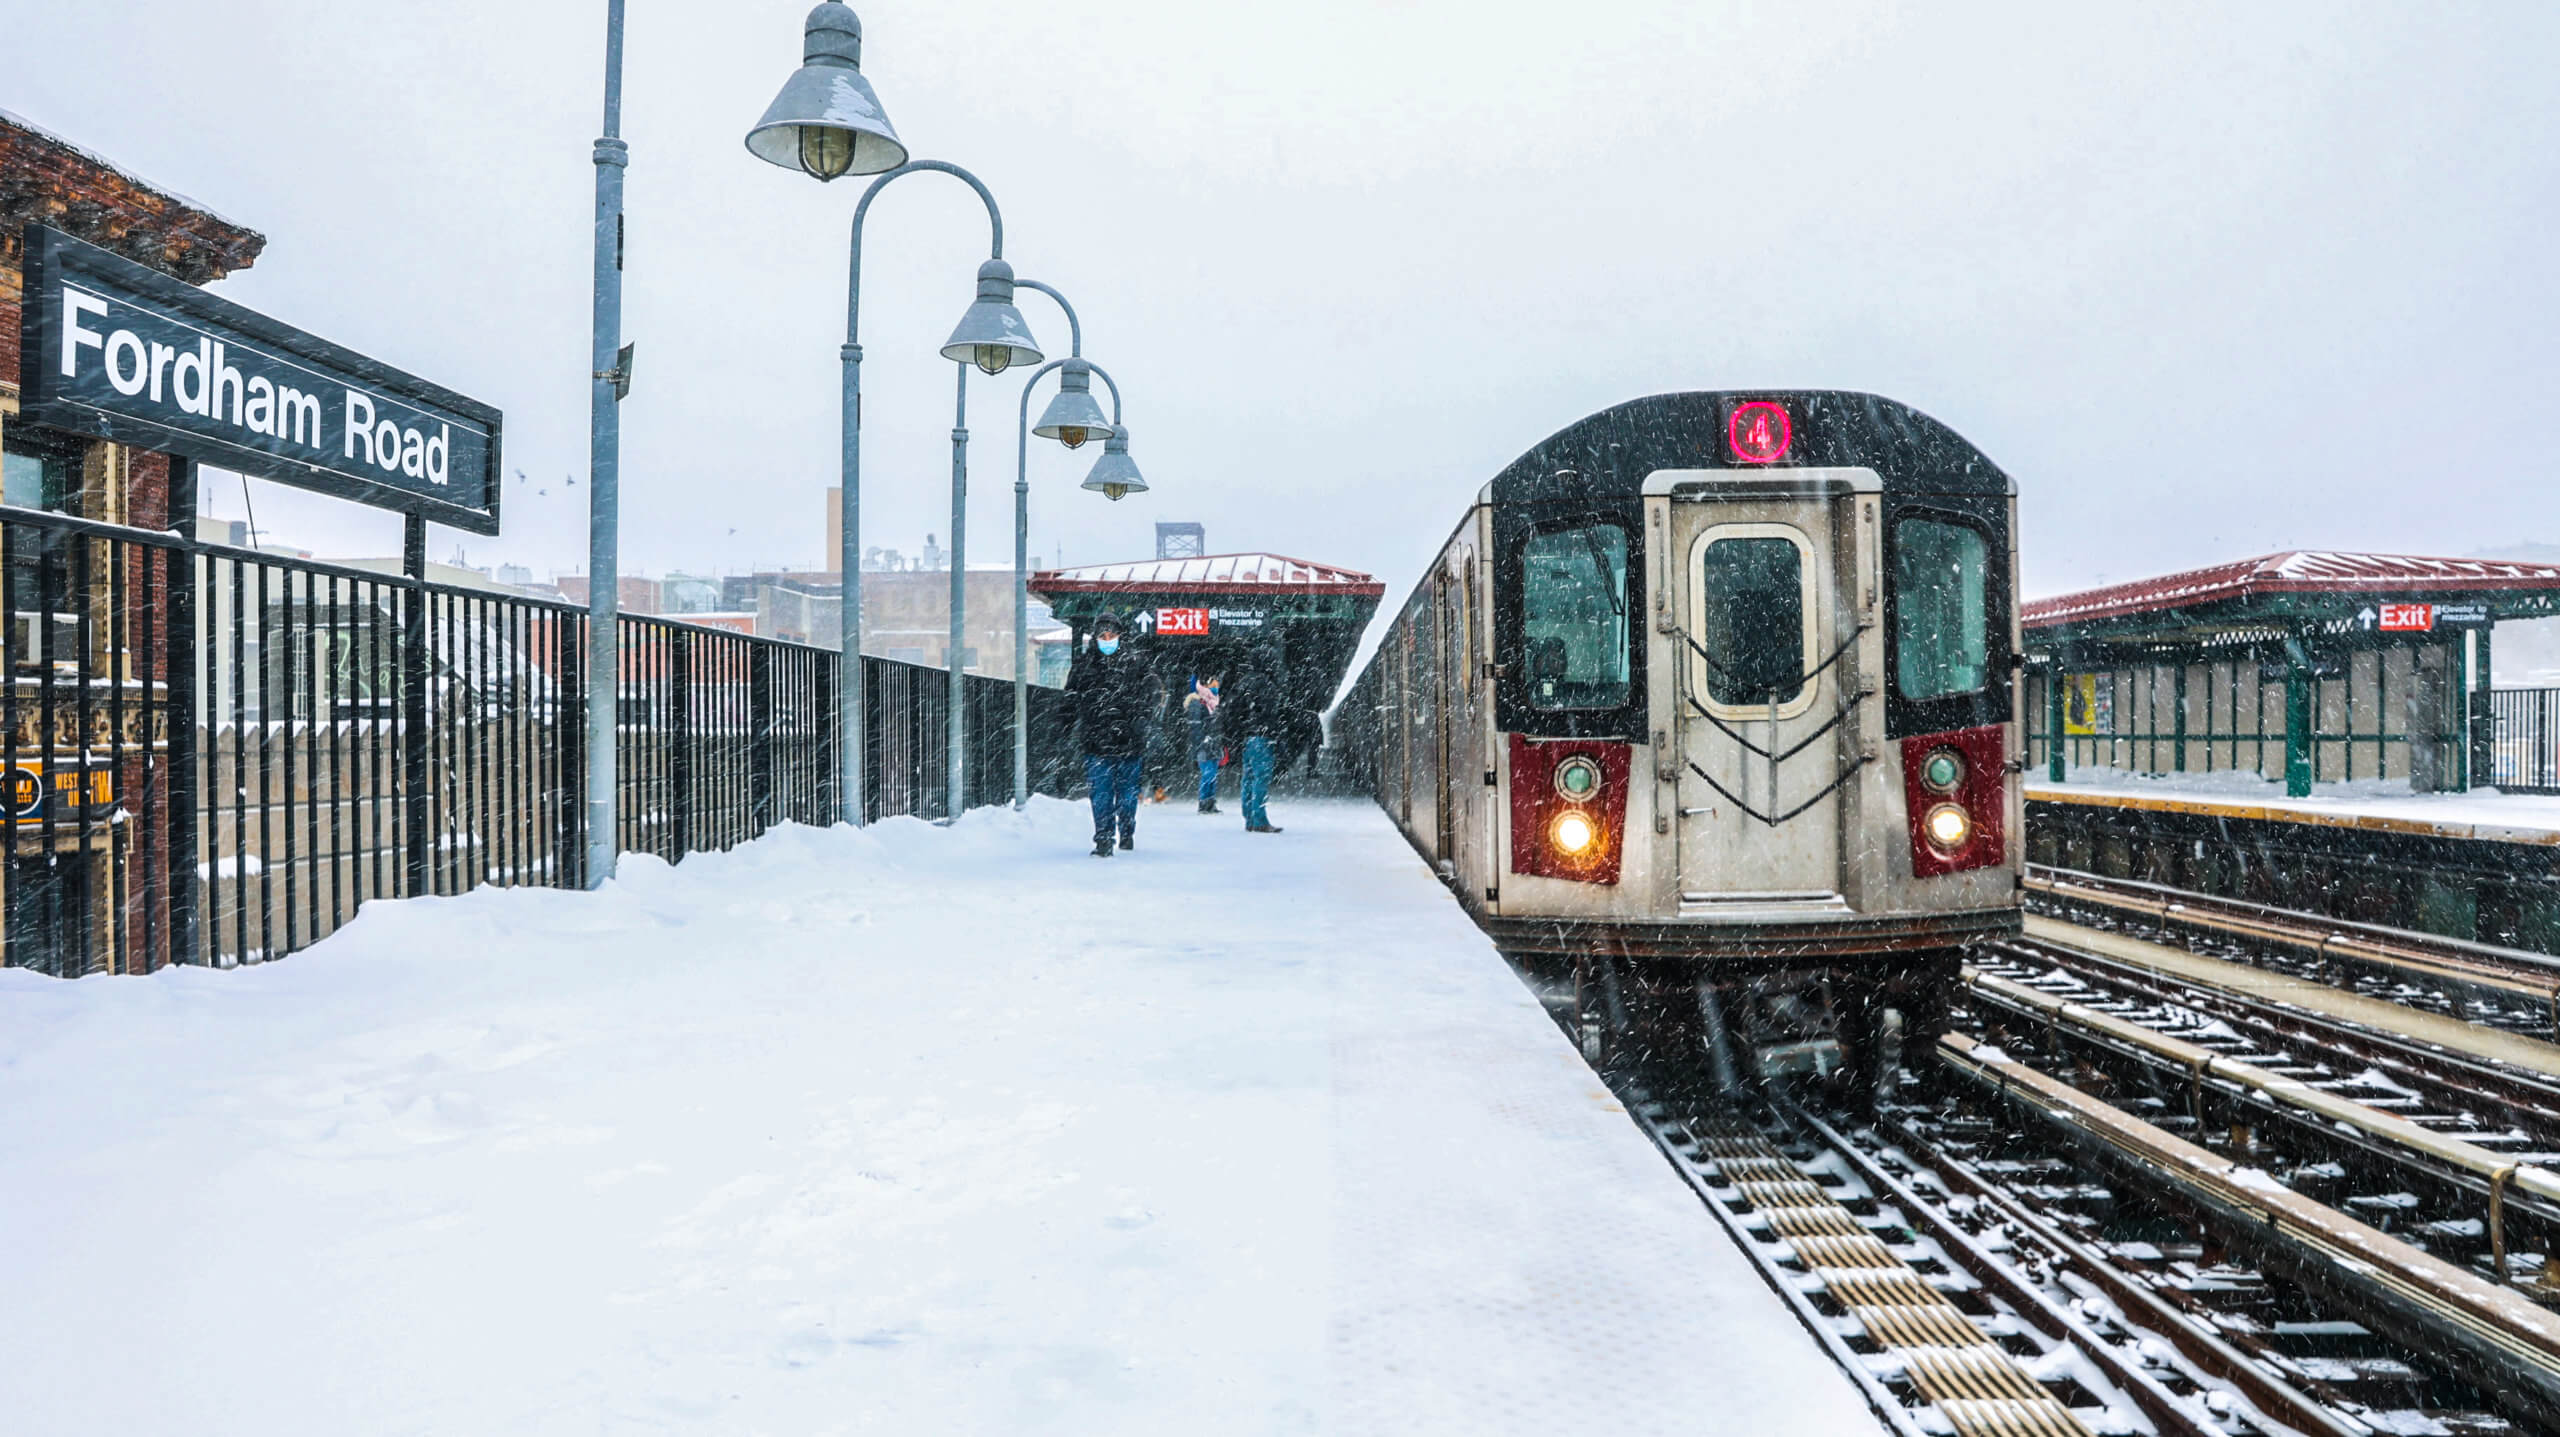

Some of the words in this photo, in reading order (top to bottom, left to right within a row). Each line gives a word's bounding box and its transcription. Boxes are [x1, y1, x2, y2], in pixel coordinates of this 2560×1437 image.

[61, 286, 322, 450] Fordham
[344, 389, 449, 486] Road
[1745, 412, 1774, 450] 4
[1156, 608, 1203, 631] Exit
[1219, 608, 1252, 618] Elevator
[1254, 608, 1264, 618] to
[1219, 618, 1263, 627] mezzanine
[2380, 604, 2427, 627] Exit
